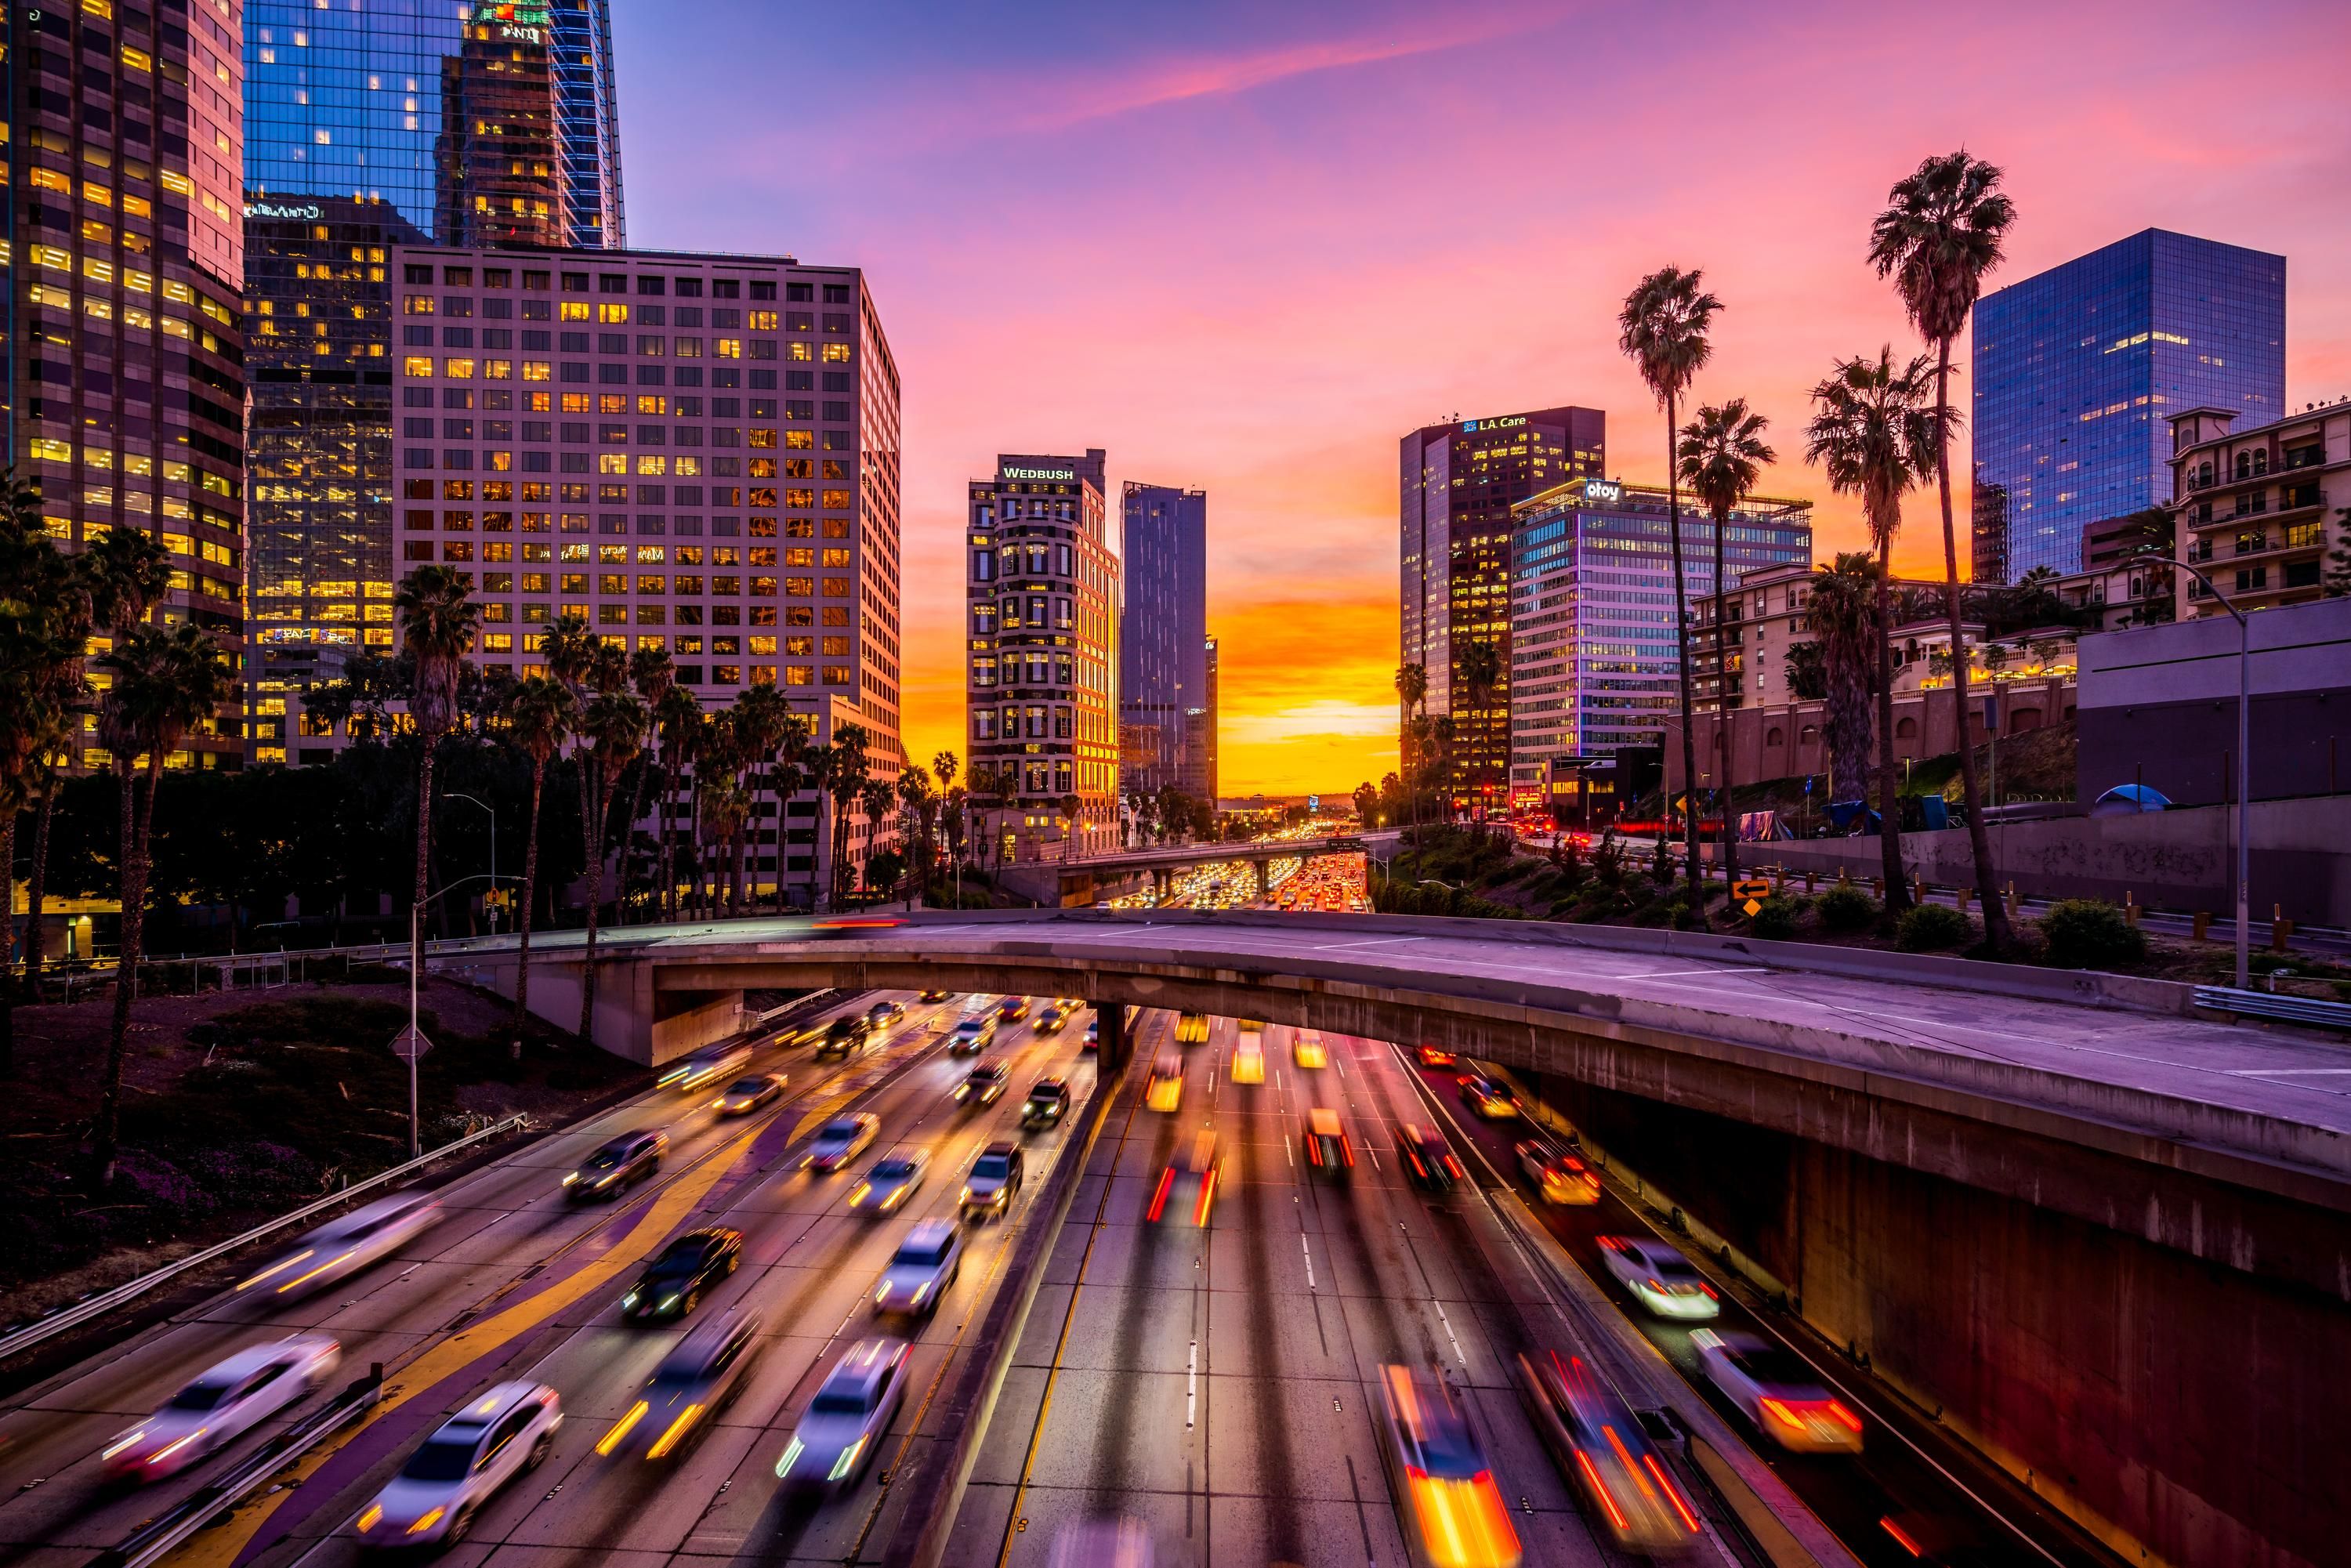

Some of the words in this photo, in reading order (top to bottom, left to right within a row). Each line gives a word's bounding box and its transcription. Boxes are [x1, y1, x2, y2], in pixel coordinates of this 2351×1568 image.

[1480, 419, 1498, 431] L.A.
[1500, 417, 1527, 427] Care
[1003, 467, 1074, 480] WEDBUSH
[1587, 482, 1620, 502] otoy
